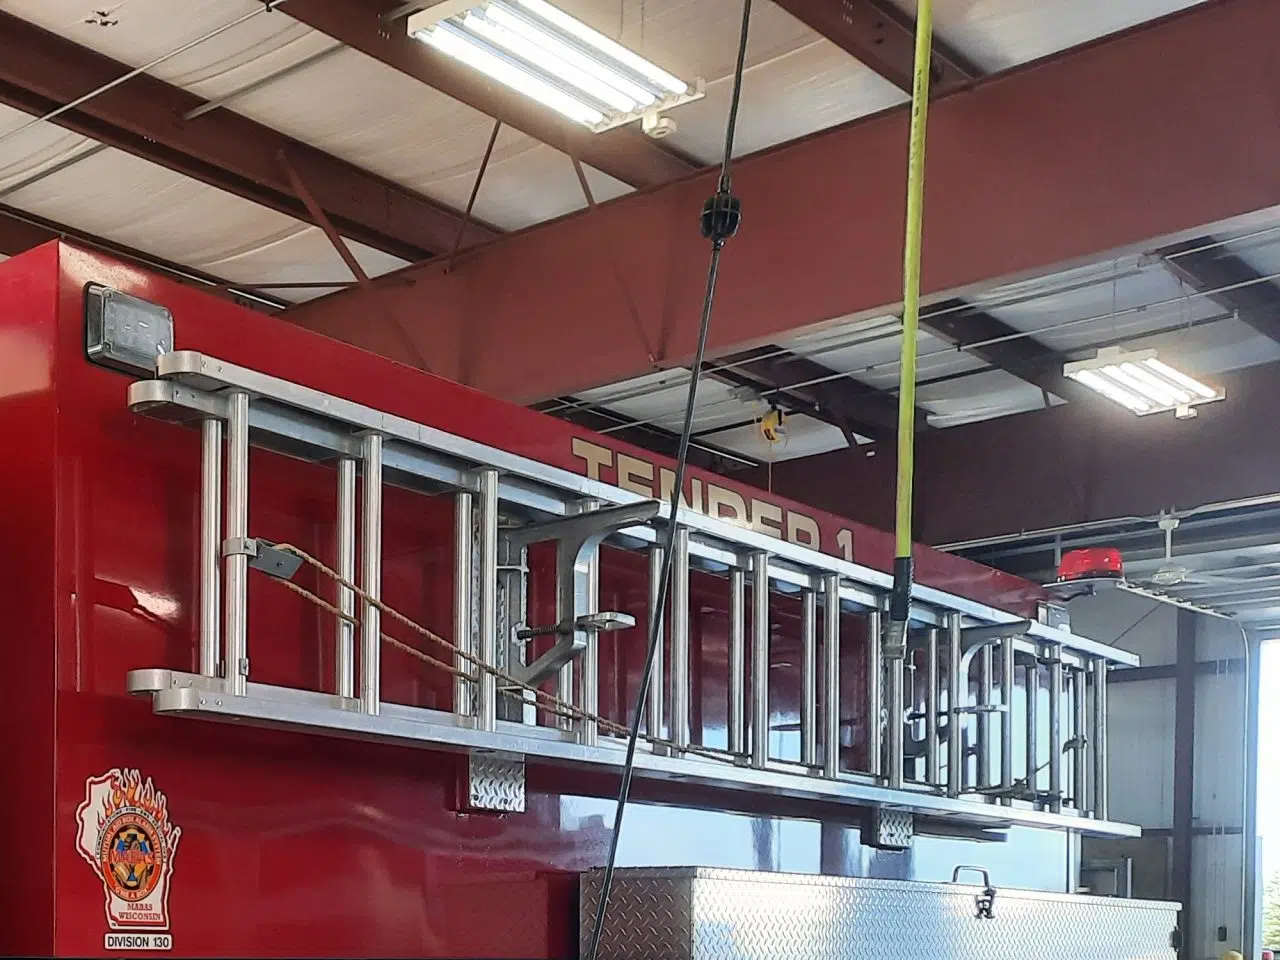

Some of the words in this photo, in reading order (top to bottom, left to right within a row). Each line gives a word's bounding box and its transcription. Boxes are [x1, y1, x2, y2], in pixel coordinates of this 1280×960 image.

[835, 527, 853, 562] 1
[127, 903, 153, 911] MABAS
[118, 911, 161, 920] WISCONSIN
[107, 936, 150, 948] DIVISION
[153, 937, 170, 948] 130
